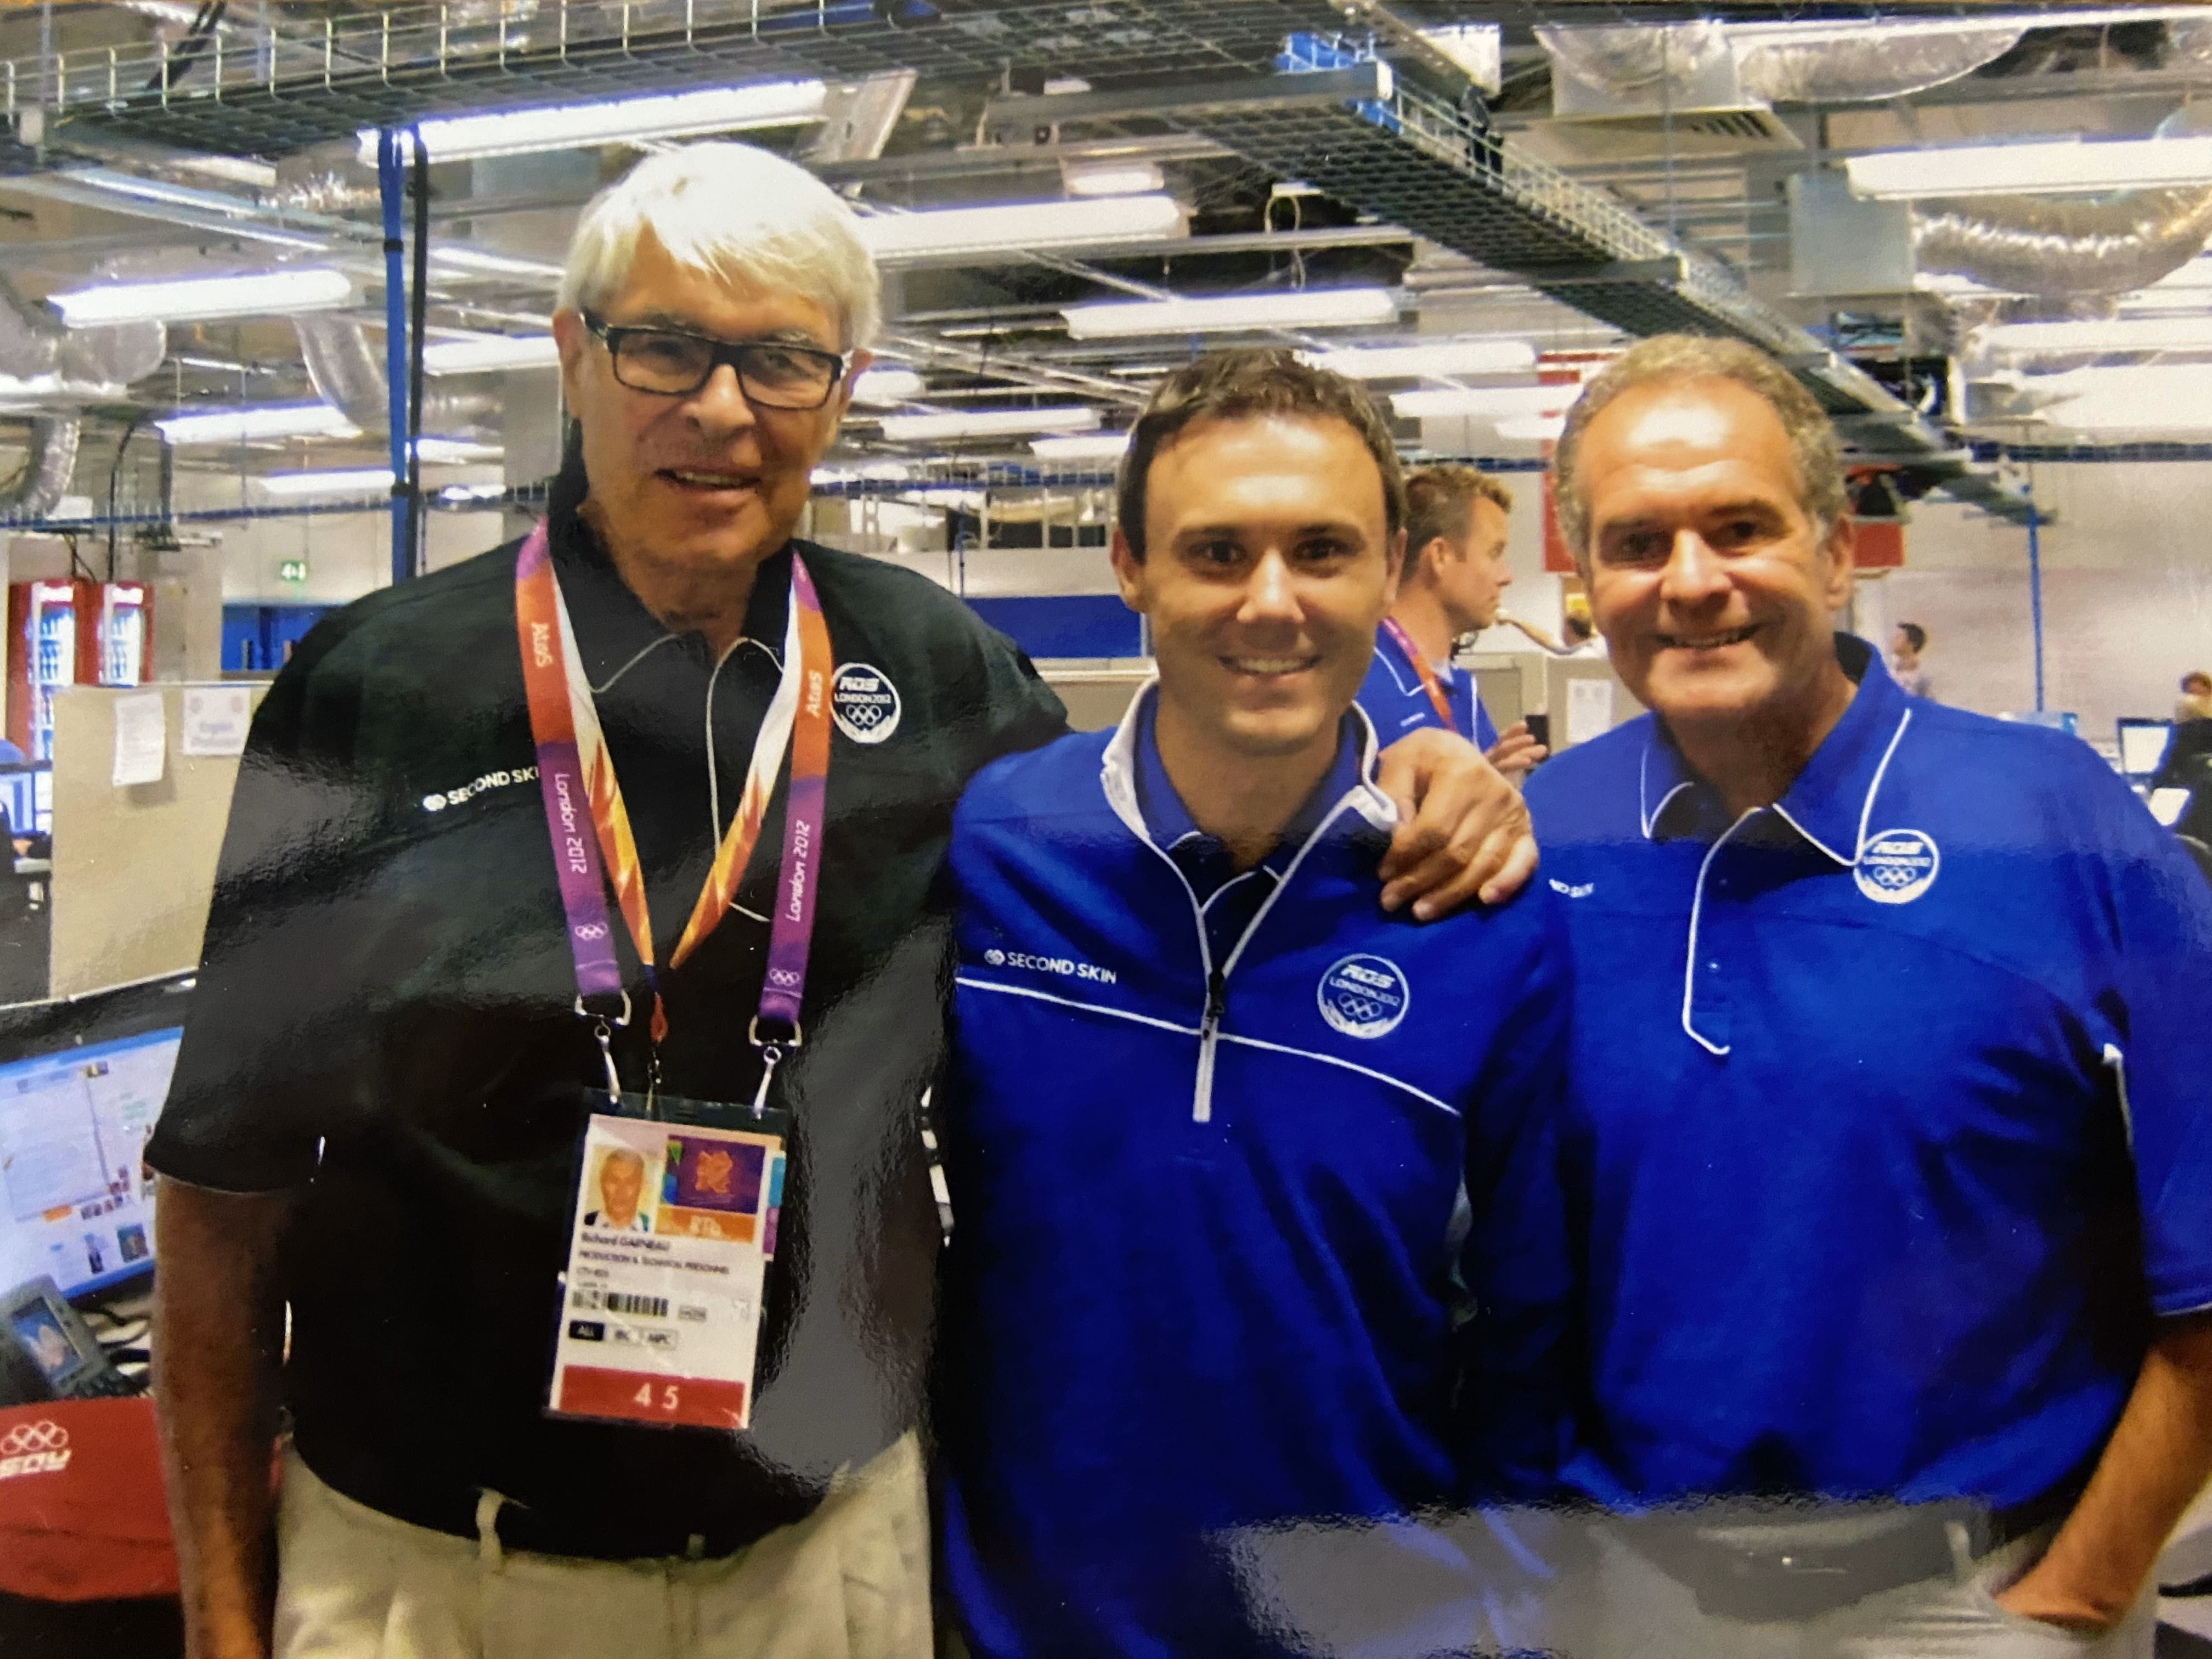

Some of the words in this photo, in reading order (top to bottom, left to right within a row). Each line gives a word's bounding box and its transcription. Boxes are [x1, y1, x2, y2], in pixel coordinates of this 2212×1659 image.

[447, 771, 510, 805] SECOND
[511, 766, 539, 783] SKI
[555, 772, 577, 833] London
[566, 837, 587, 874] 2012
[793, 820, 810, 859] 2012
[785, 861, 806, 922] London
[1007, 951, 1075, 975] SECOND
[1076, 963, 1117, 984] SKIN
[634, 1383, 652, 1407] 4
[661, 1385, 679, 1410] 5
